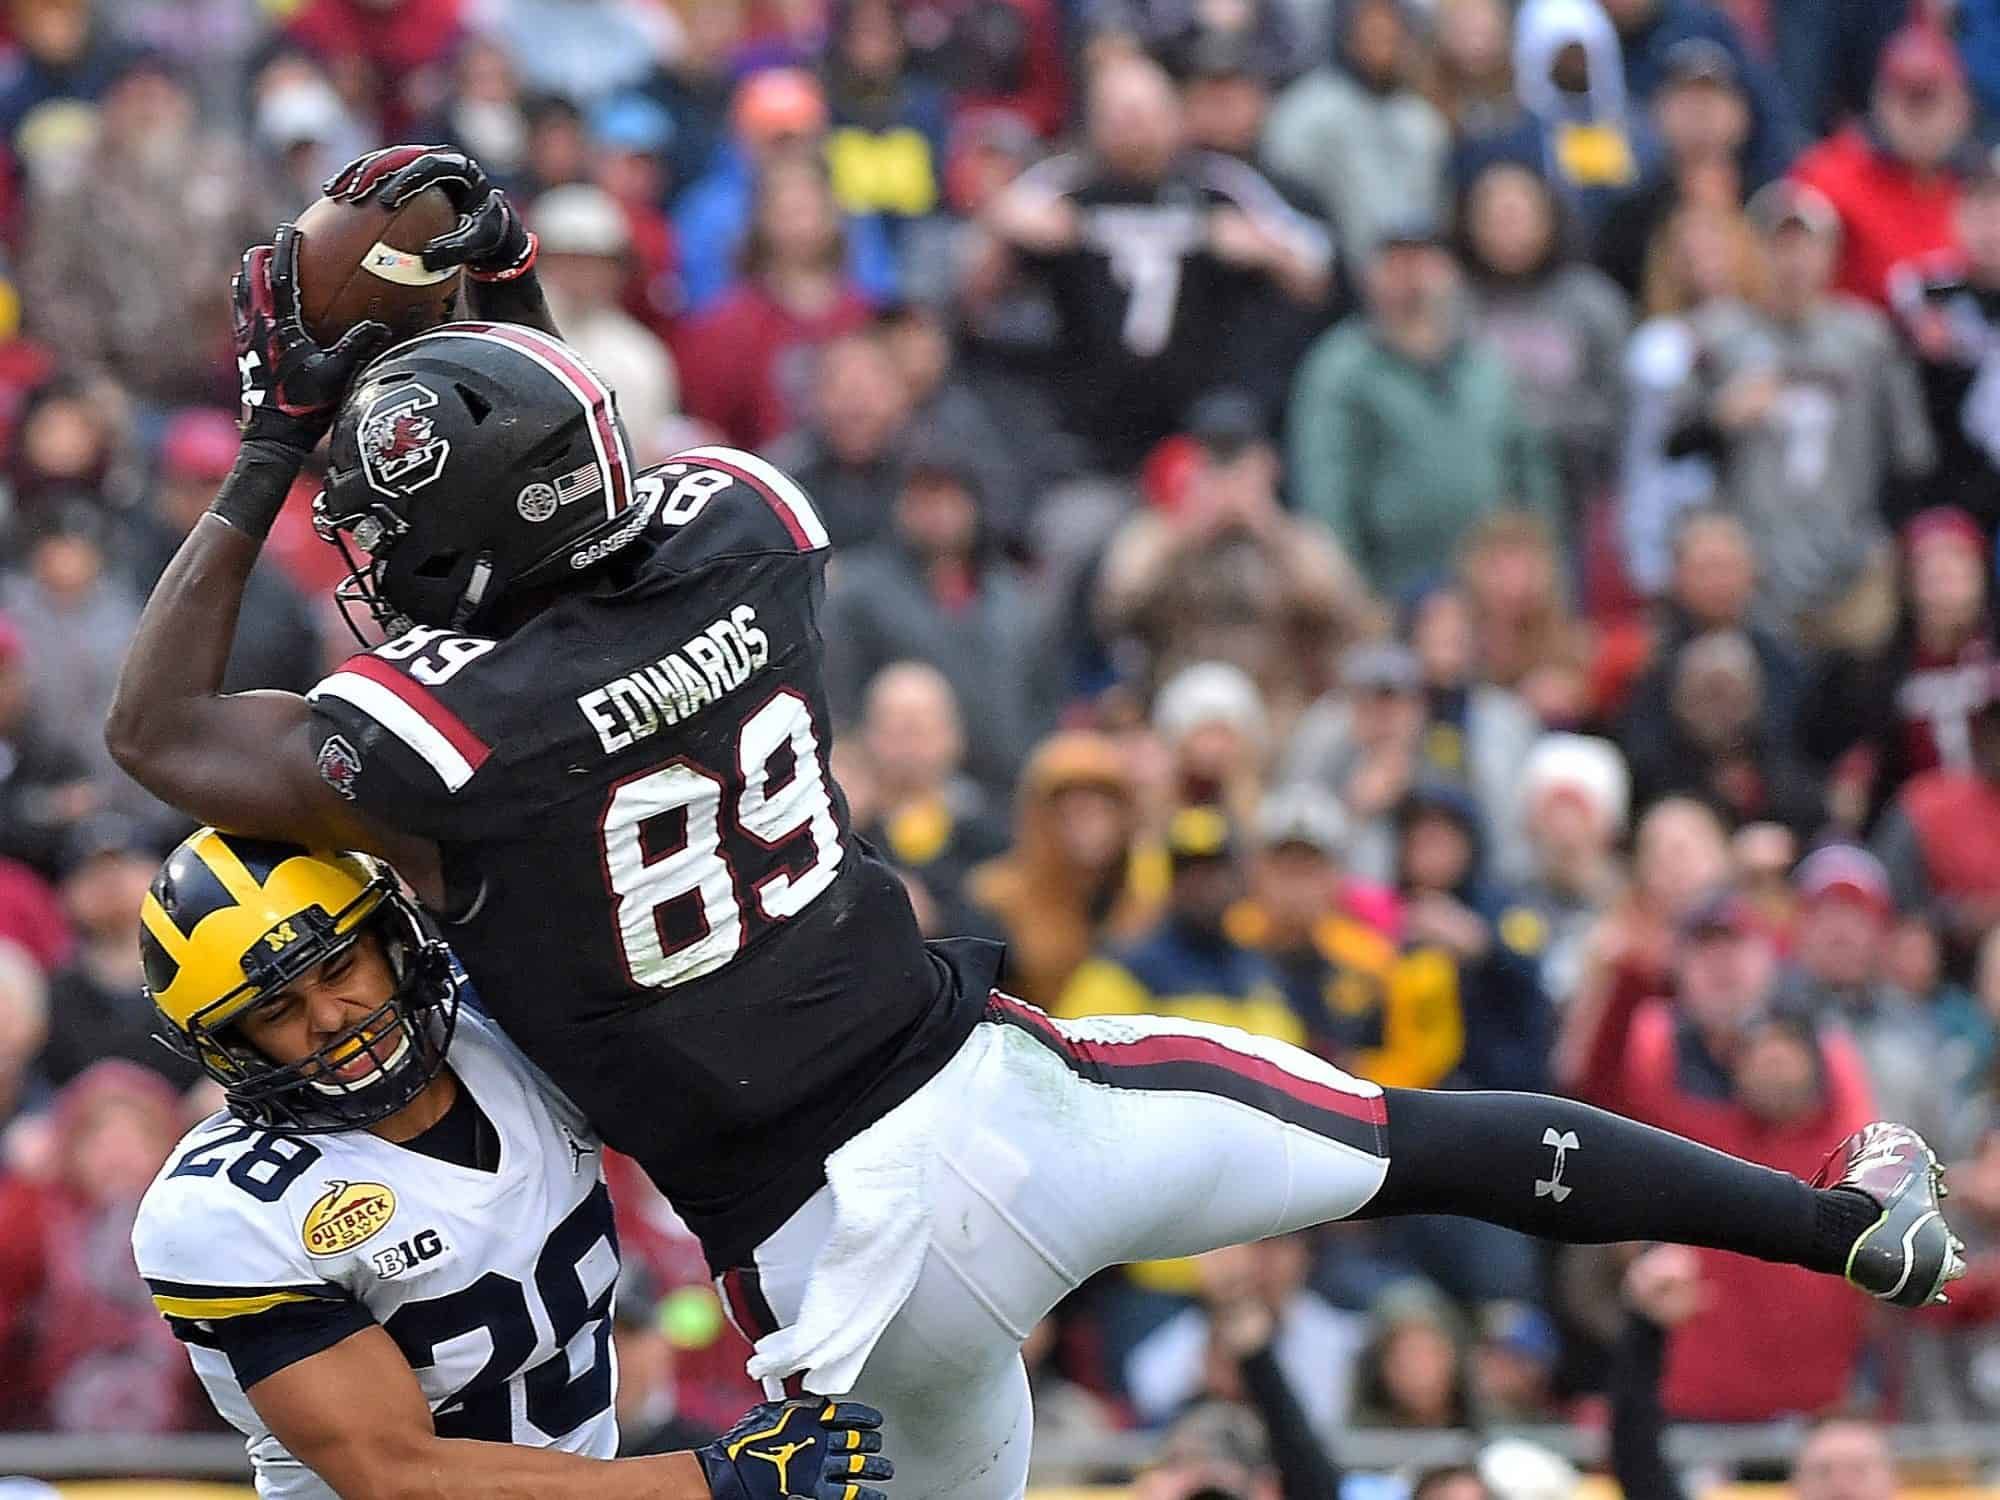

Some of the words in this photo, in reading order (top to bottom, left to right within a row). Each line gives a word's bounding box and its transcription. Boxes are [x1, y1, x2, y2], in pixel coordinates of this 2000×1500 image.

[577, 604, 770, 755] EDWARDS
[602, 686, 846, 989] 89
[264, 921, 299, 952] M
[165, 1125, 324, 1203] 28
[311, 1198, 389, 1247] OUTBACK
[383, 1179, 622, 1442] 28
